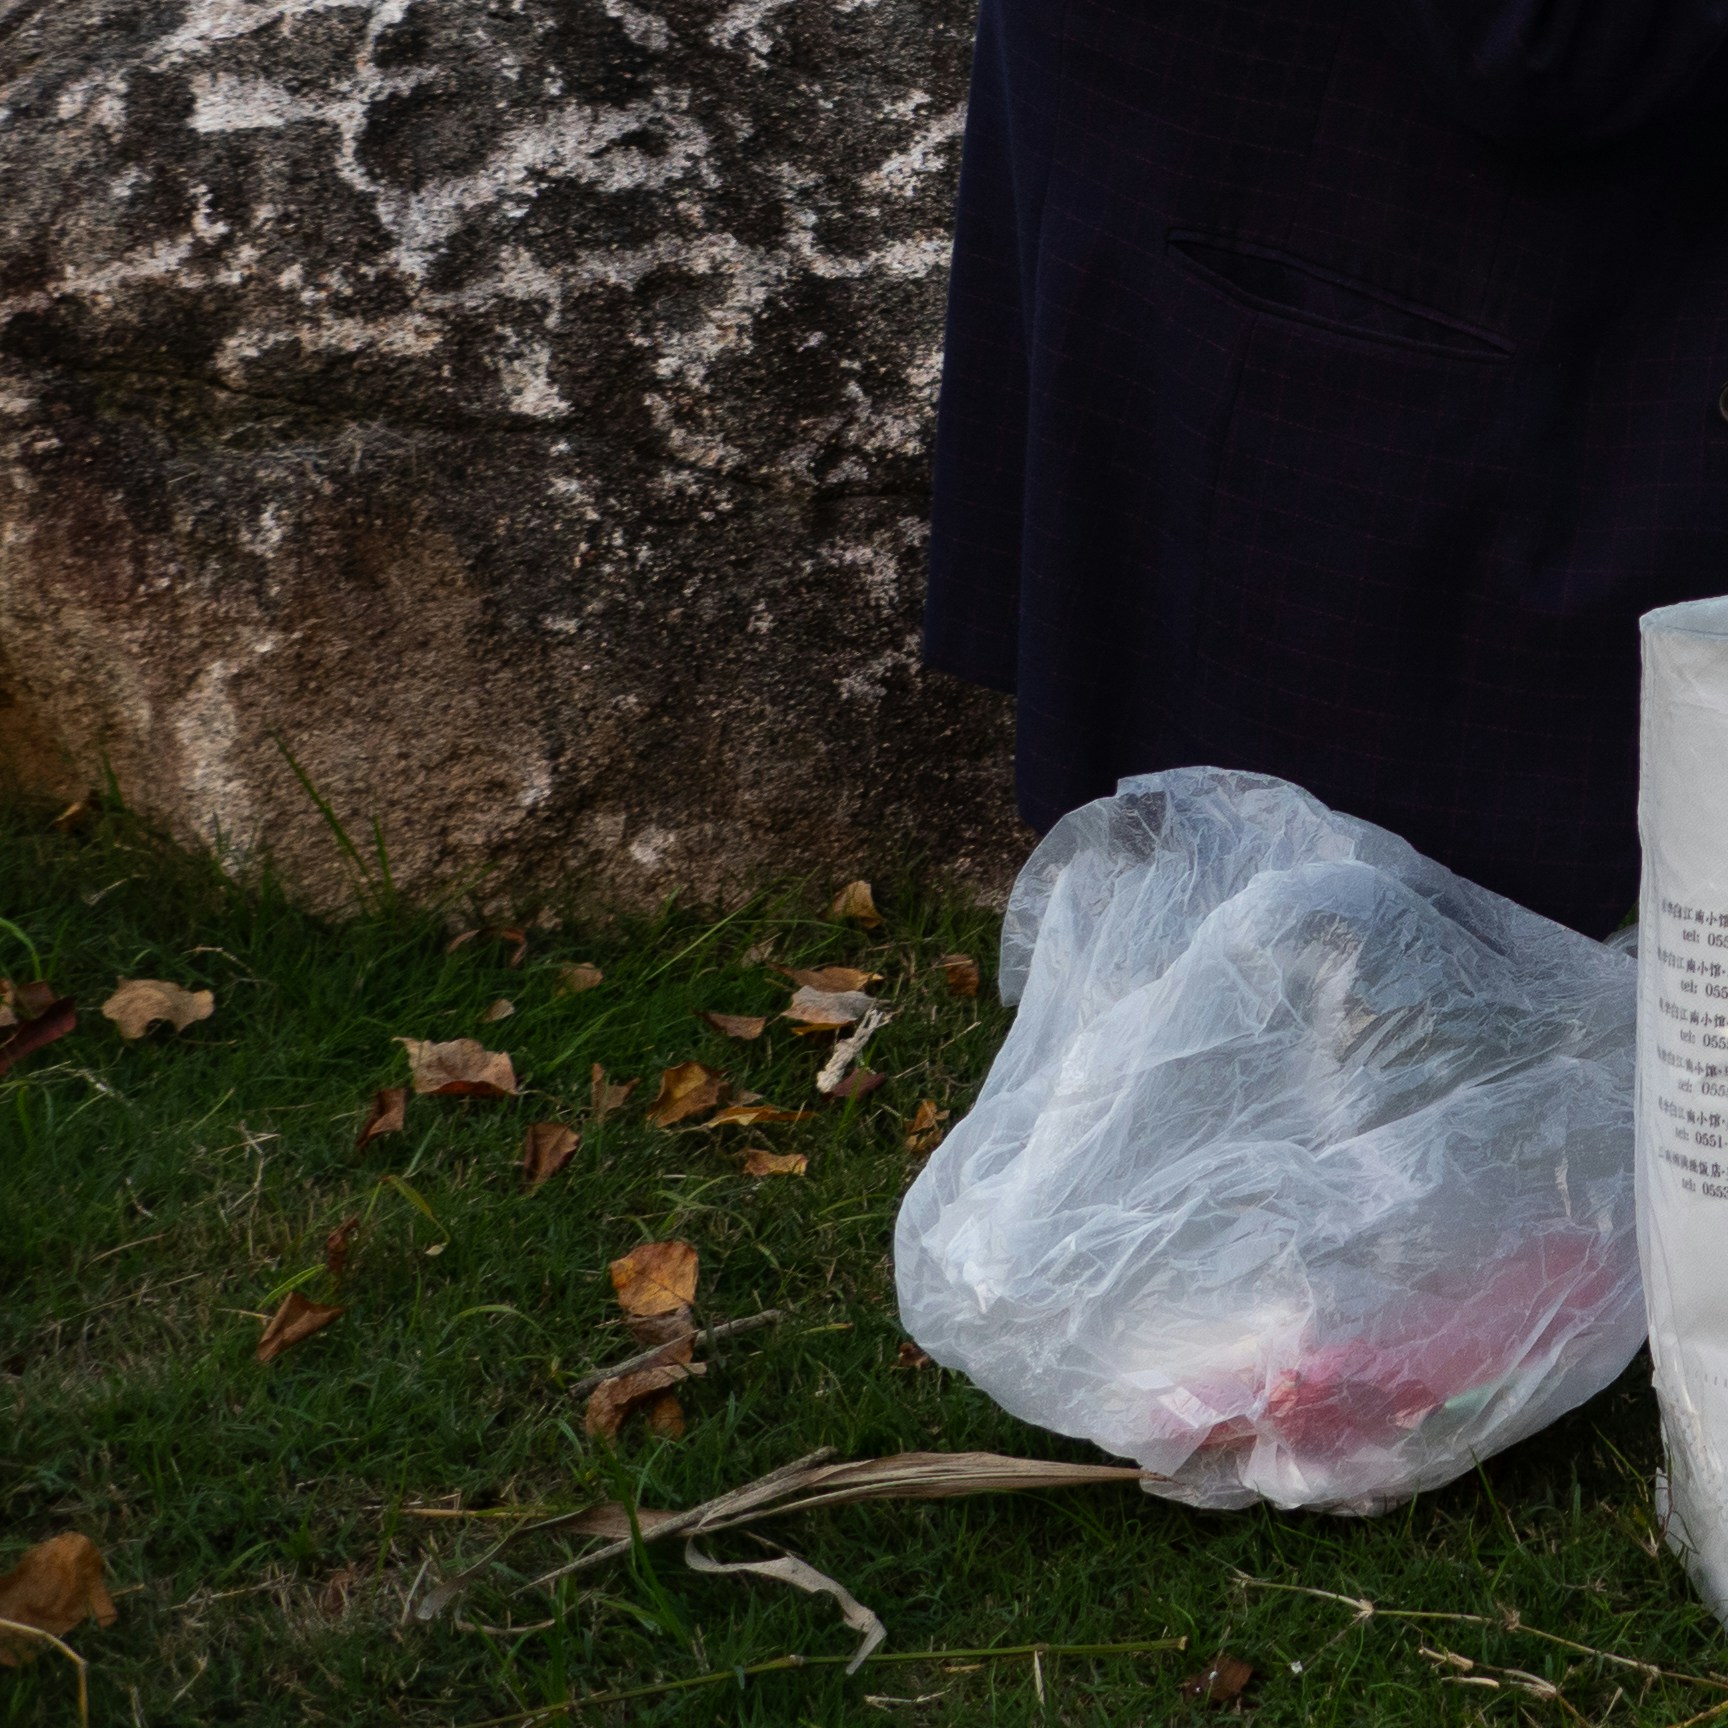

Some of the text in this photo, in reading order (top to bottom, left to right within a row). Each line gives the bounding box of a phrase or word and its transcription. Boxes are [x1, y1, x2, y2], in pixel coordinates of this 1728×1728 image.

[1682, 928, 1700, 943] tel:
[1680, 979, 1697, 994] tel:
[1679, 1029, 1696, 1044] tel:
[1678, 1079, 1693, 1093] tel:
